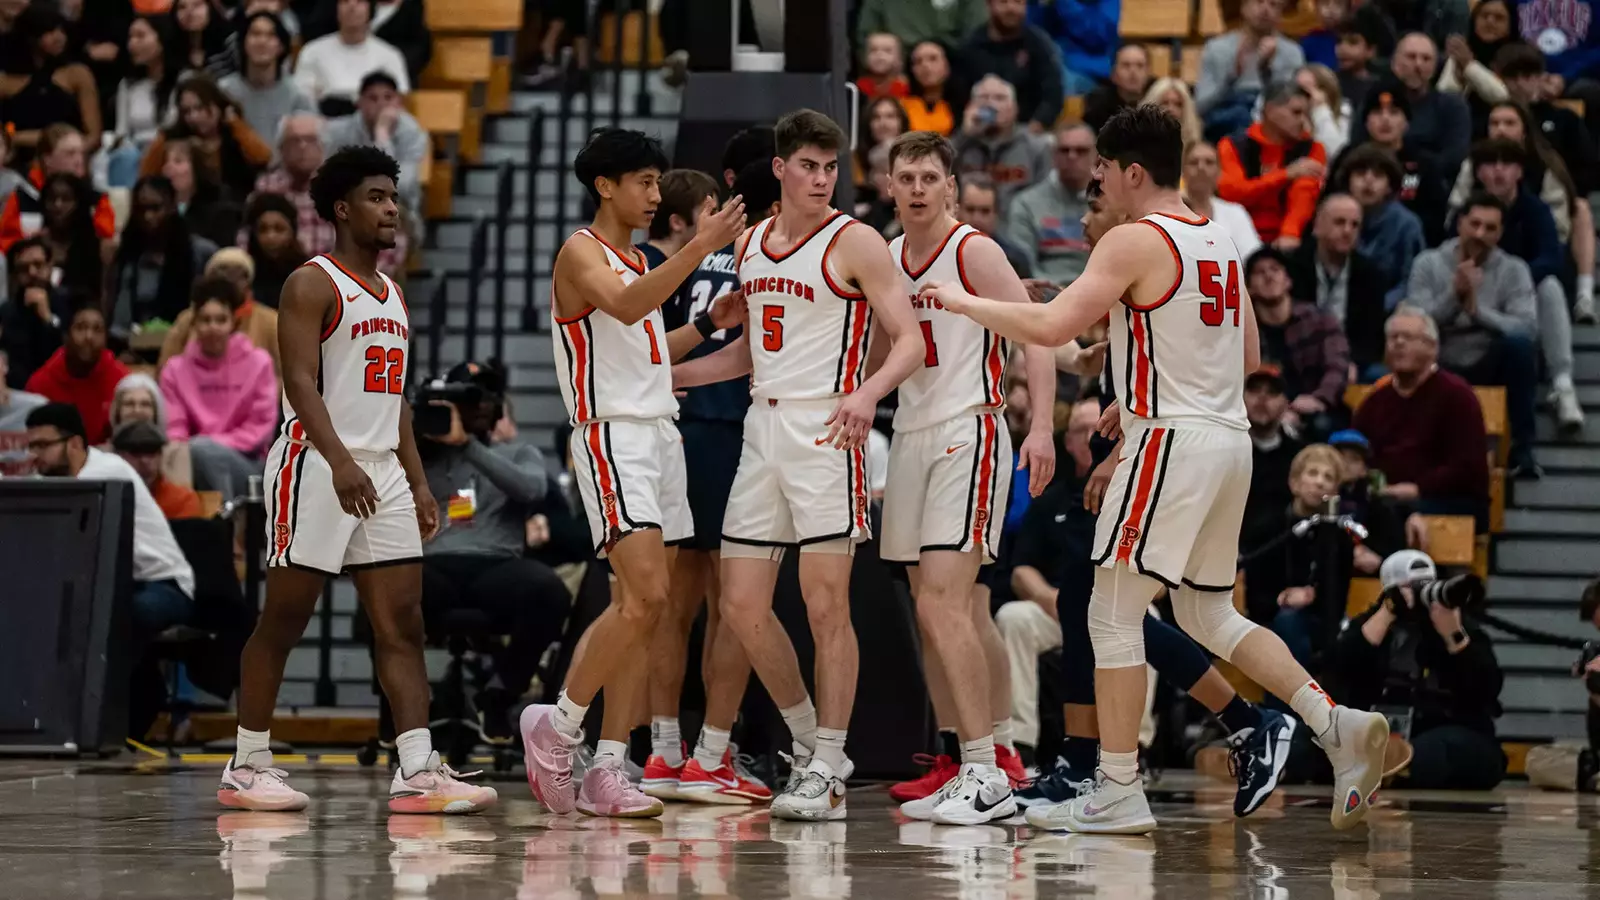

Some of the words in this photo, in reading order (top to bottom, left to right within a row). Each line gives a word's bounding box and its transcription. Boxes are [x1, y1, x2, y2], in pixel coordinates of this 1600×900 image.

[742, 277, 814, 302] RINCETON
[1197, 260, 1240, 328] 54
[351, 317, 409, 341] PRINCETO
[643, 319, 662, 365] 1
[762, 304, 785, 352] 5
[363, 344, 405, 395] 22
[1120, 525, 1142, 548] P
